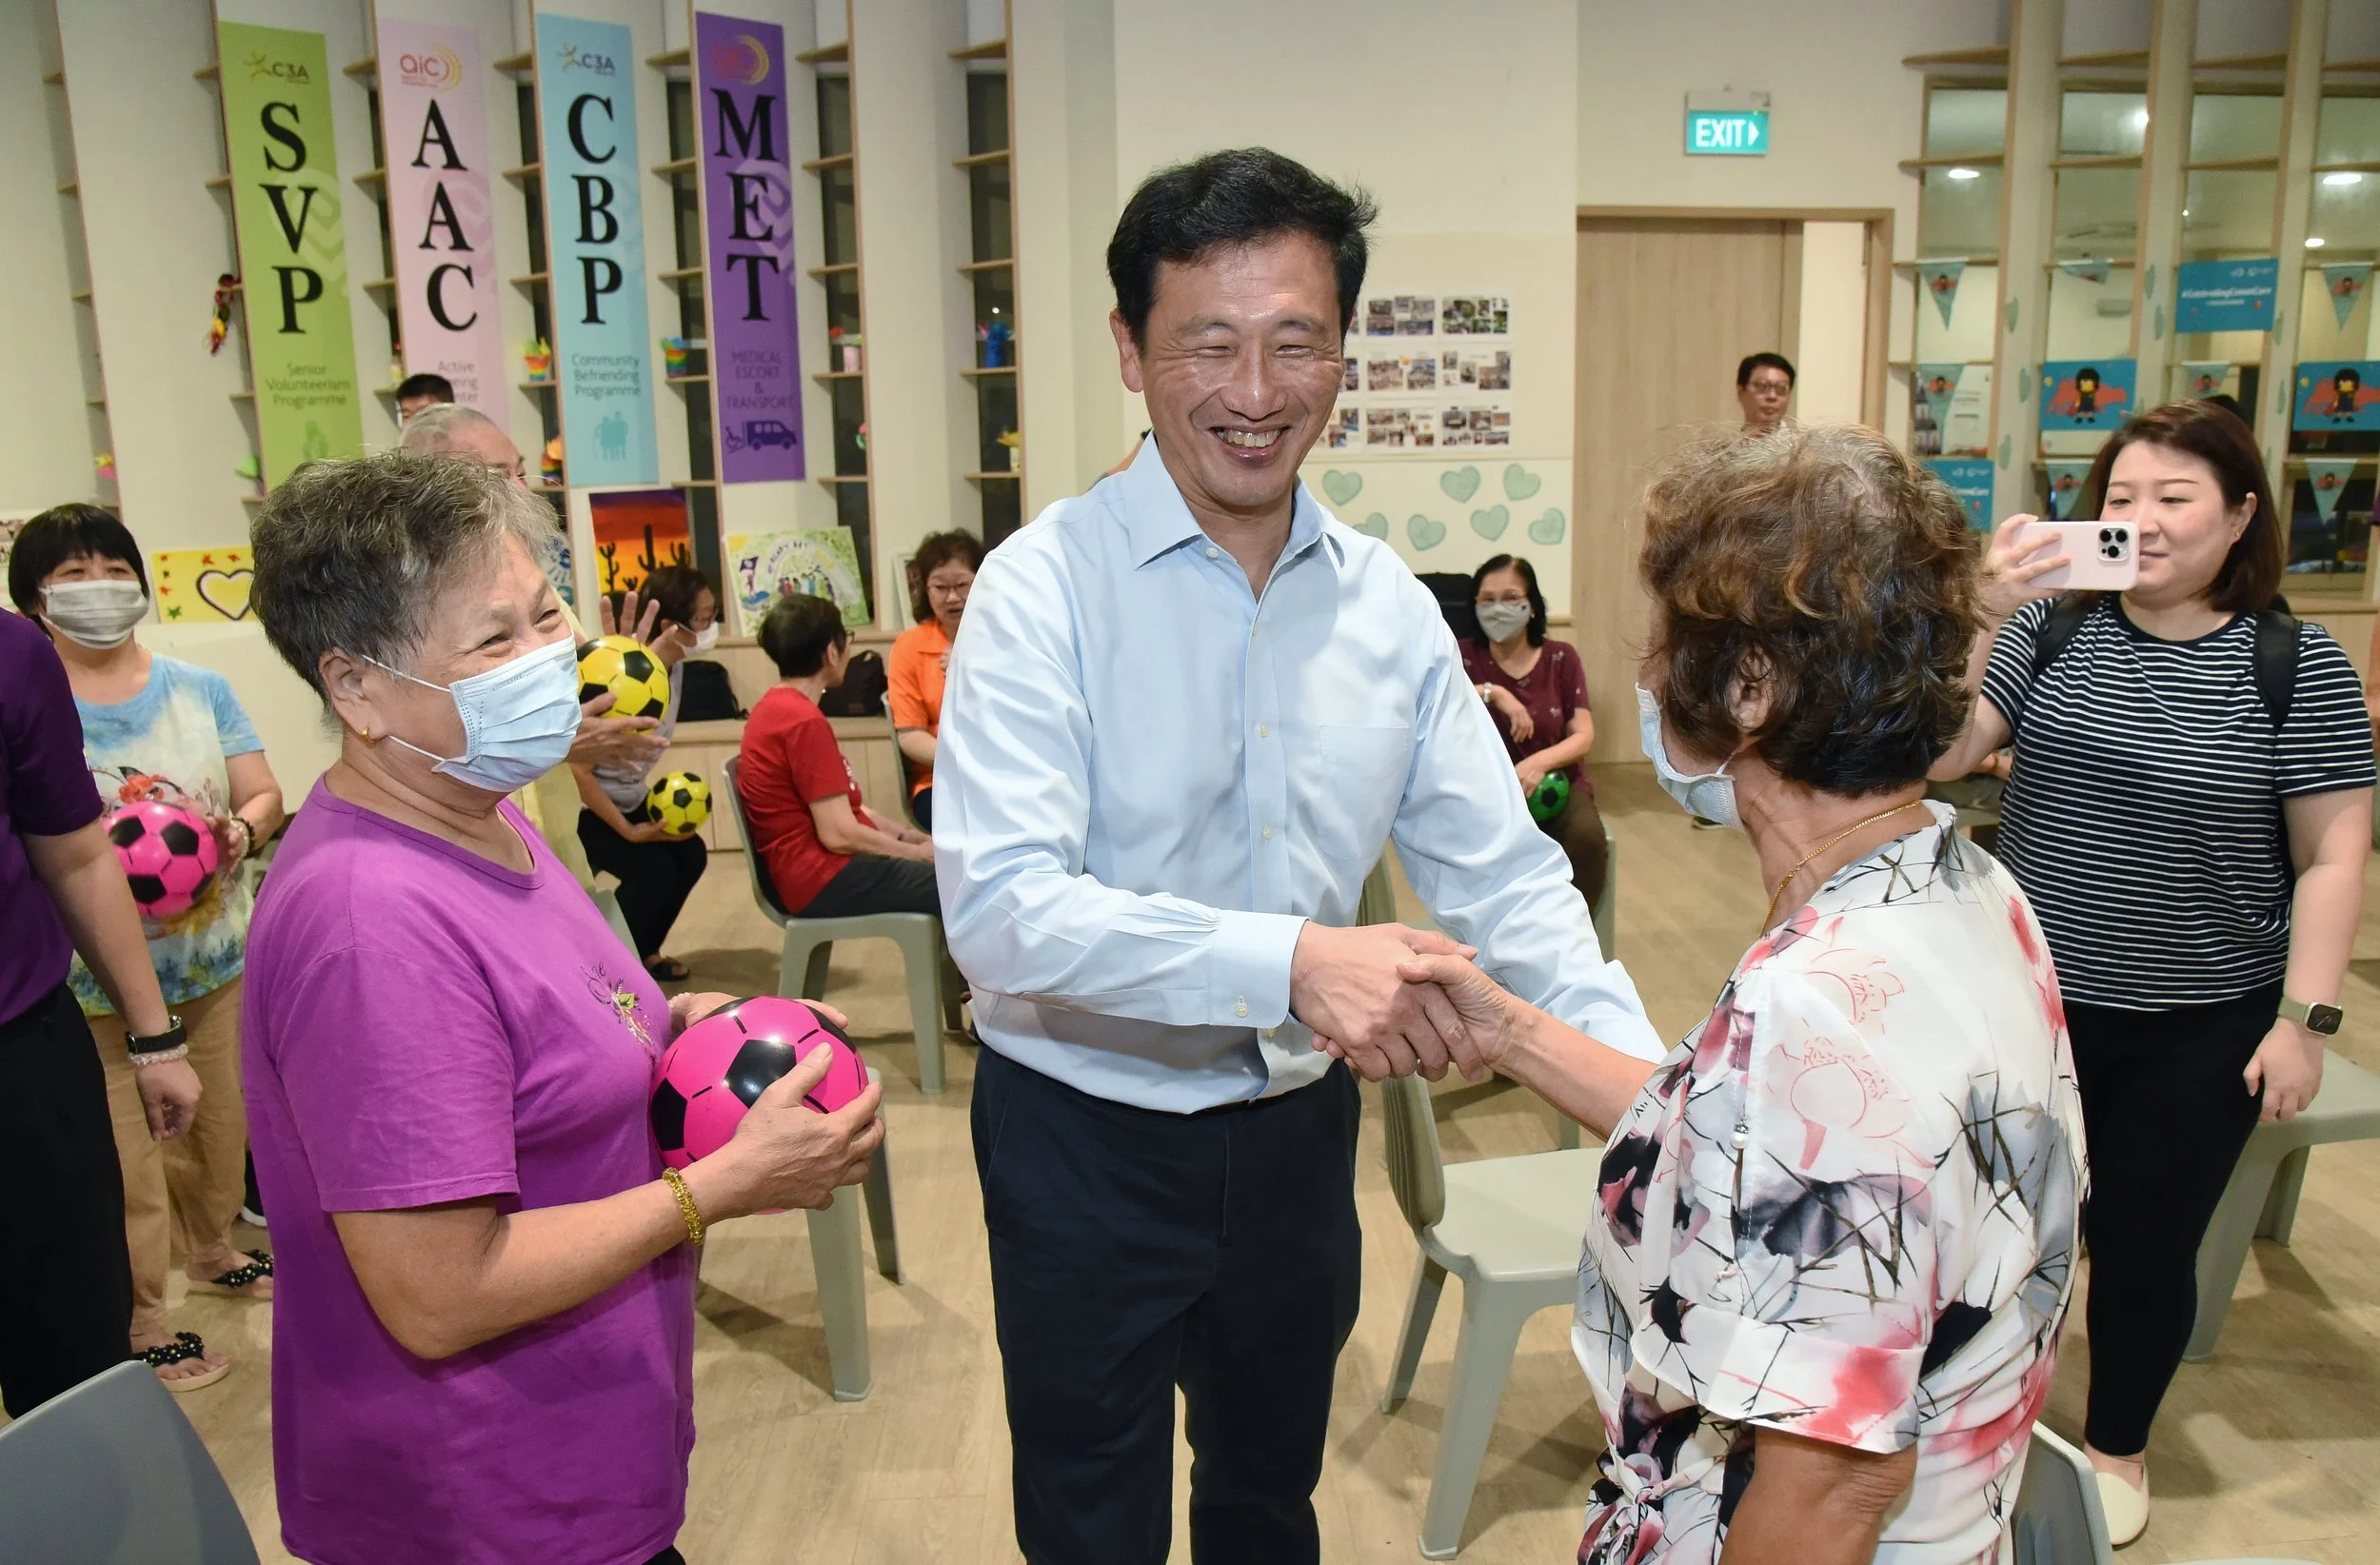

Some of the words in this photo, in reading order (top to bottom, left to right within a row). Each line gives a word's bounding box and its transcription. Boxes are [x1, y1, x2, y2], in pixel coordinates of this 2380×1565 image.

[1696, 118, 1747, 148] EXIT
[566, 93, 624, 325] CBP
[710, 88, 779, 322] MET
[260, 101, 324, 334] SVP
[411, 98, 478, 332] AAC
[572, 353, 640, 367] Community
[731, 350, 782, 364] MEDICAL
[287, 363, 327, 377] Senior
[438, 361, 475, 372] Active
[735, 365, 779, 379] ESCORT
[574, 368, 640, 386] Befriending
[267, 379, 351, 391] Volunteerism
[754, 382, 764, 394] &
[574, 385, 641, 401] Programme
[272, 393, 347, 410] Programme
[726, 395, 793, 409] TRANSPORT
